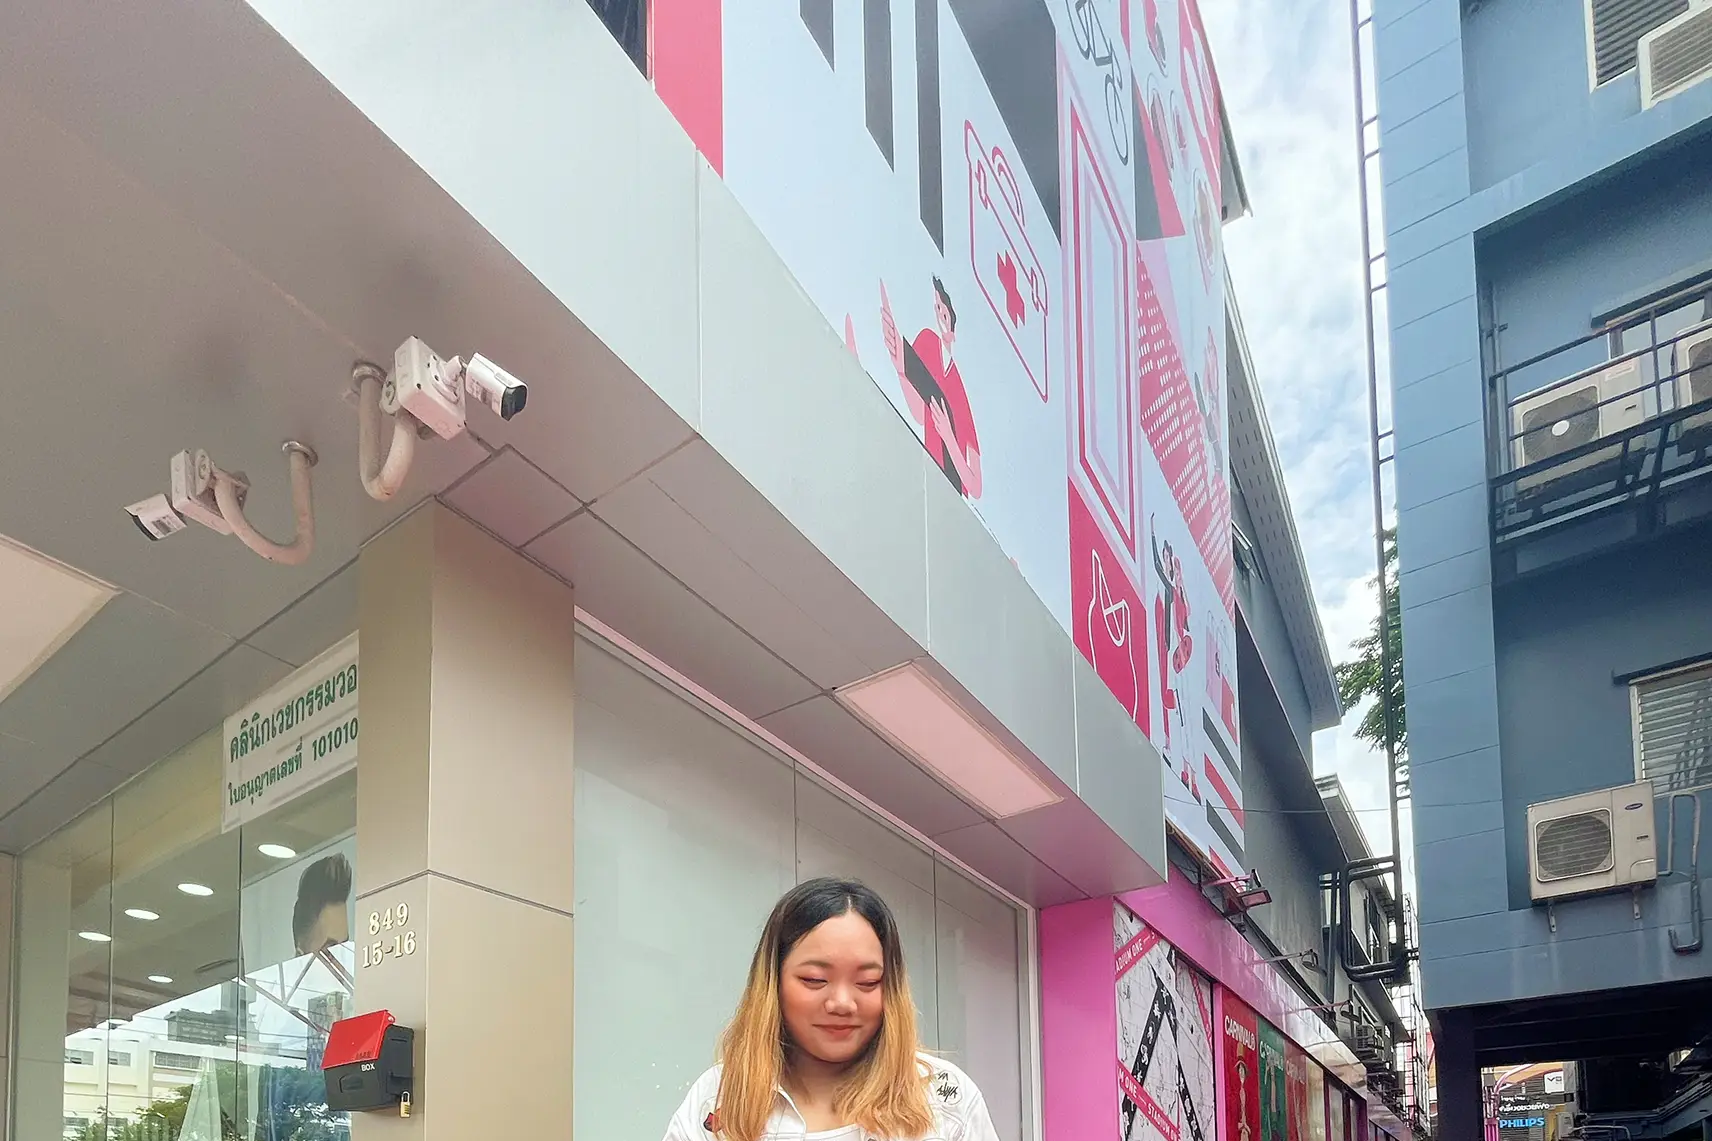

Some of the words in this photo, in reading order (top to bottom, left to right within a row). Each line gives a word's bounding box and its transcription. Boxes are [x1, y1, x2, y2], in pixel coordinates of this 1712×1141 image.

[368, 902, 409, 936] 849
[362, 931, 416, 969] 15-16
[361, 1063, 375, 1072] BOX
[1499, 1117, 1545, 1129] PHILIPS
